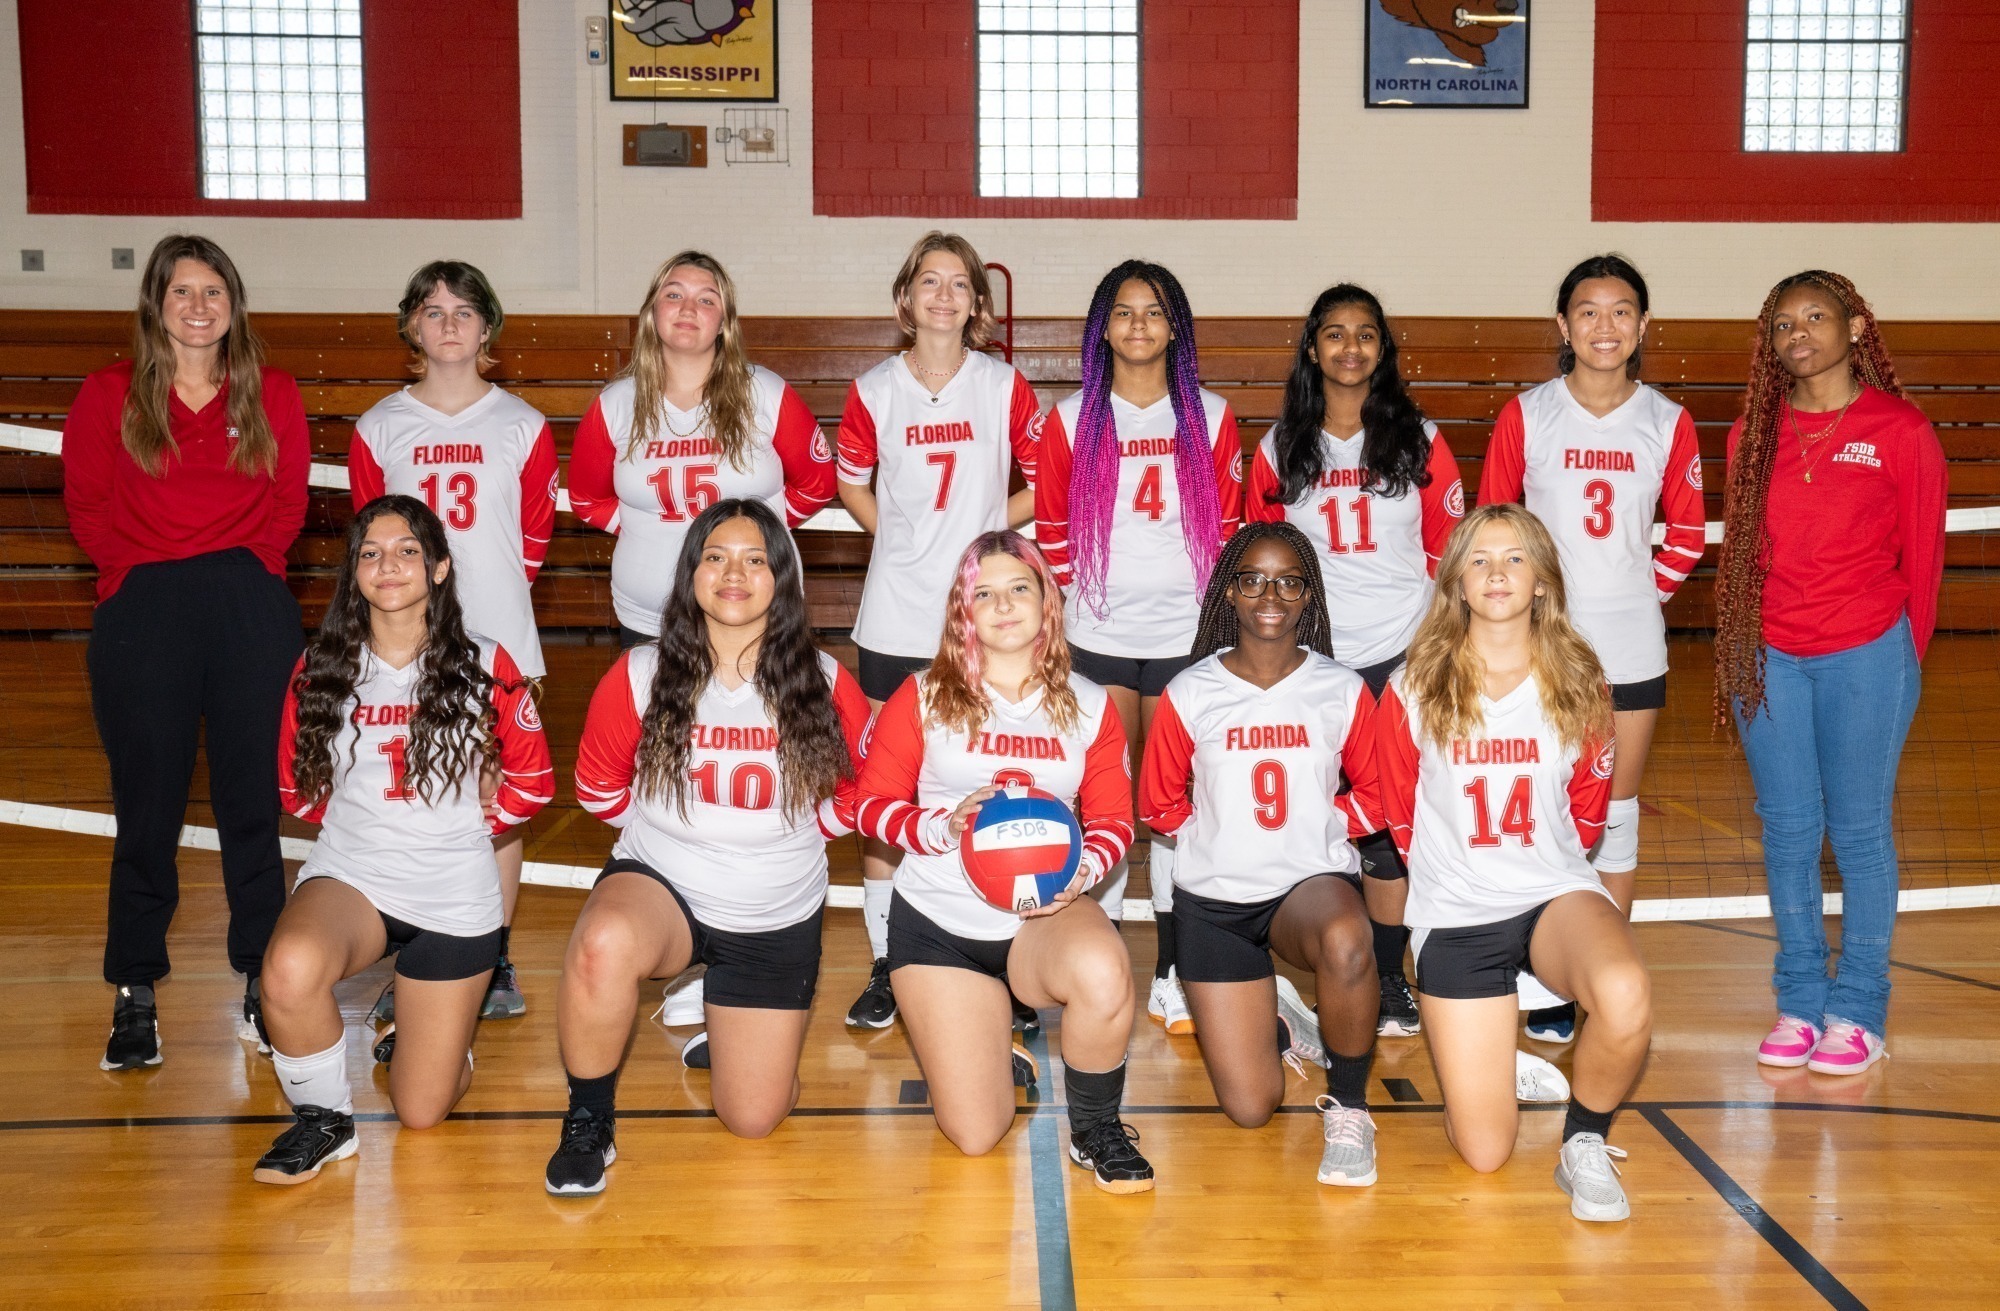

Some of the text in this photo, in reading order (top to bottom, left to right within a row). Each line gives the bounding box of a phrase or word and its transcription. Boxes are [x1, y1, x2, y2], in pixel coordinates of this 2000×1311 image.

[629, 66, 760, 82] MISSISSIPPI
[1375, 79, 1518, 91] NORTH CAROLINA
[1029, 358, 1081, 367] DO NOT SIT
[905, 420, 974, 446] FLORIDA
[413, 444, 484, 465] FLORIDA
[644, 438, 724, 459] FLORIDA
[1119, 438, 1176, 457] LORIDA
[1843, 443, 1876, 457] FSDB
[1564, 449, 1635, 472] FLORIDA
[1832, 453, 1881, 468] ATHLETICS
[926, 451, 956, 511] 7
[1311, 468, 1382, 490] LORID
[418, 471, 477, 531] 13
[647, 464, 721, 522] 15
[1133, 464, 1166, 521] 4
[1584, 478, 1615, 540] 3
[1318, 494, 1377, 554] 11
[354, 704, 421, 726] FLOR
[1226, 724, 1310, 751] FLORIDA
[1453, 738, 1540, 765] FLORIDA
[688, 760, 776, 810] 10
[1251, 759, 1288, 831] 9
[1464, 775, 1535, 848] 14
[996, 820, 1048, 840] FSDB
